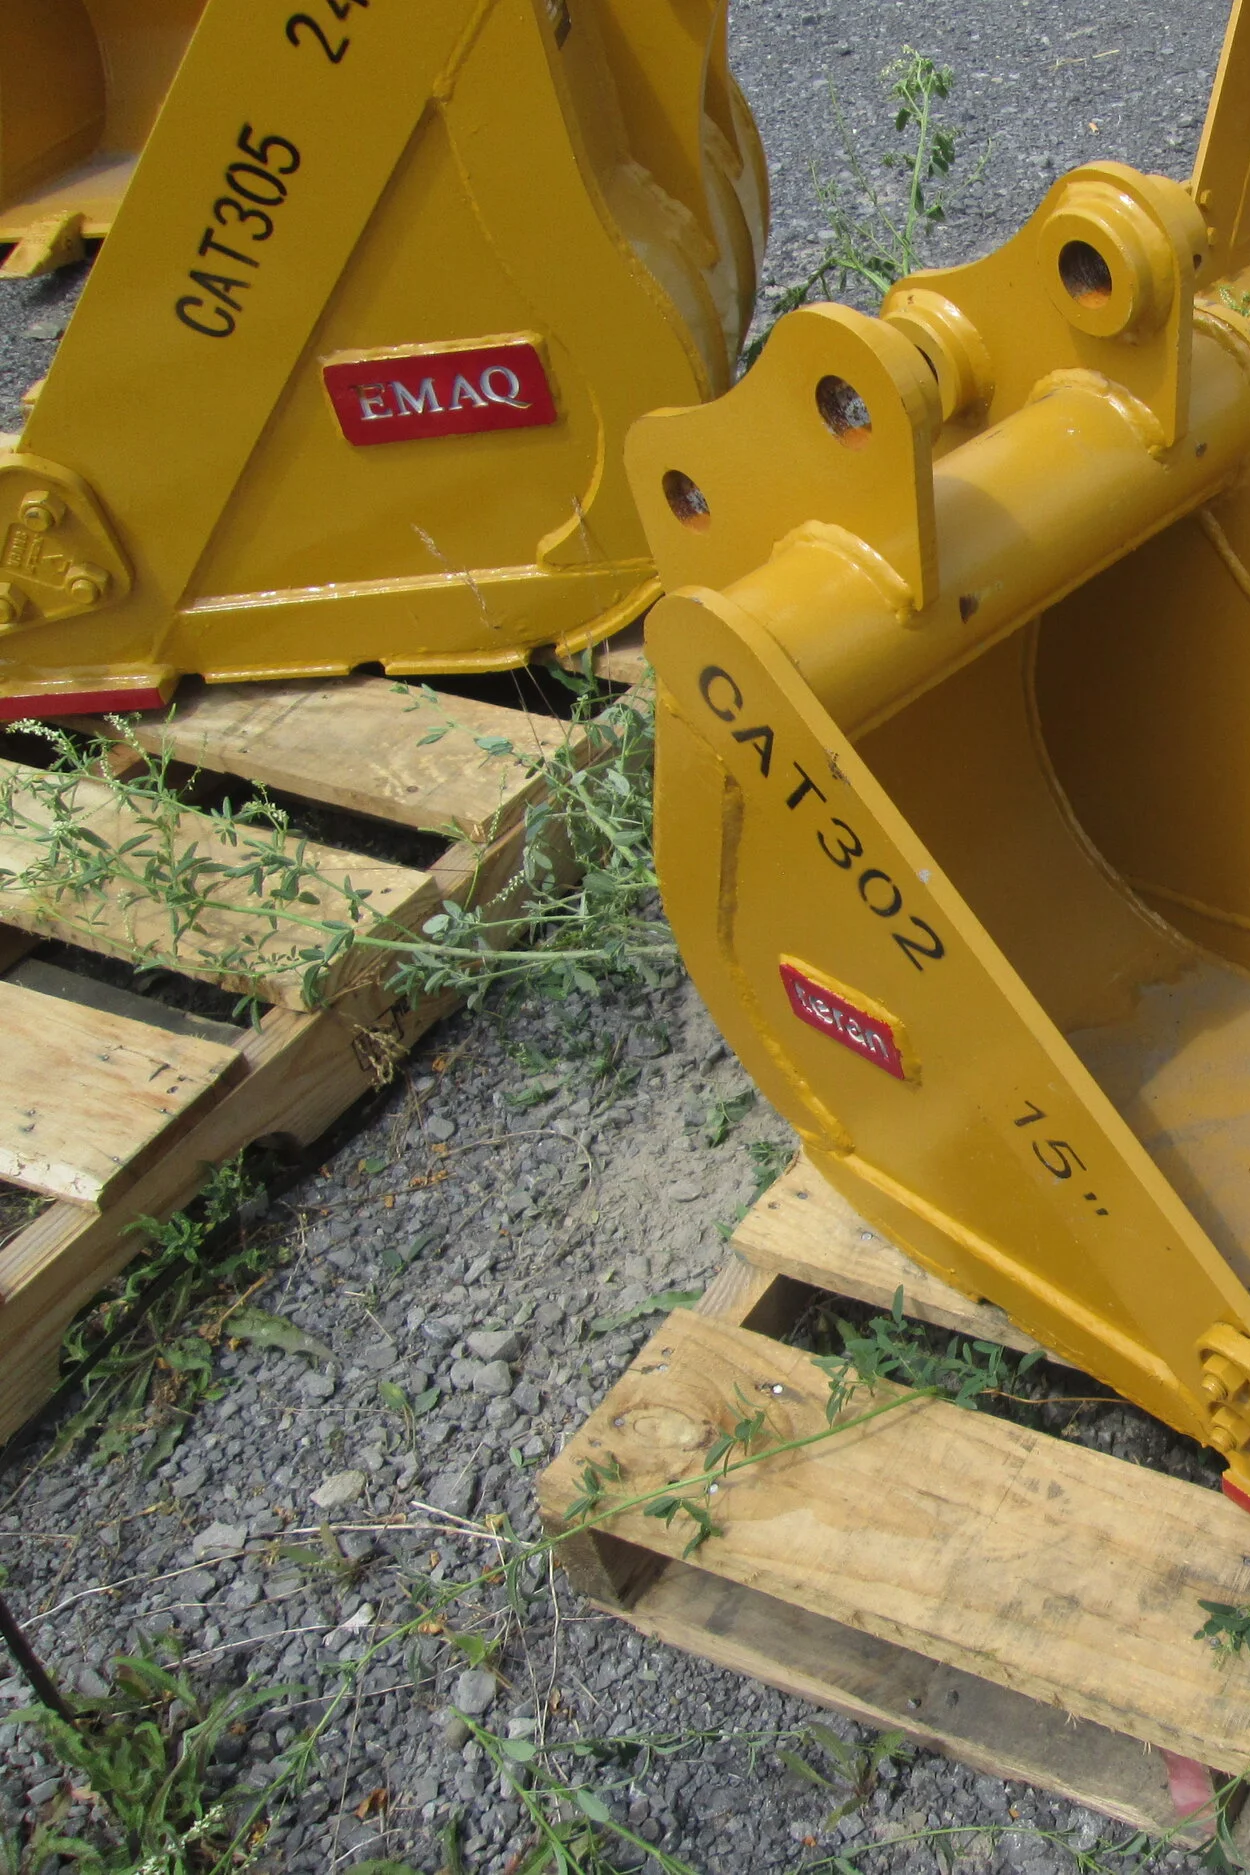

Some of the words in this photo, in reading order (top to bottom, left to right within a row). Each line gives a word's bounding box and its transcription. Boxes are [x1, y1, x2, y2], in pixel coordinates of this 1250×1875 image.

[175, 123, 300, 338] CAT305
[355, 365, 534, 421] EMAQ
[699, 665, 945, 971] CAT302
